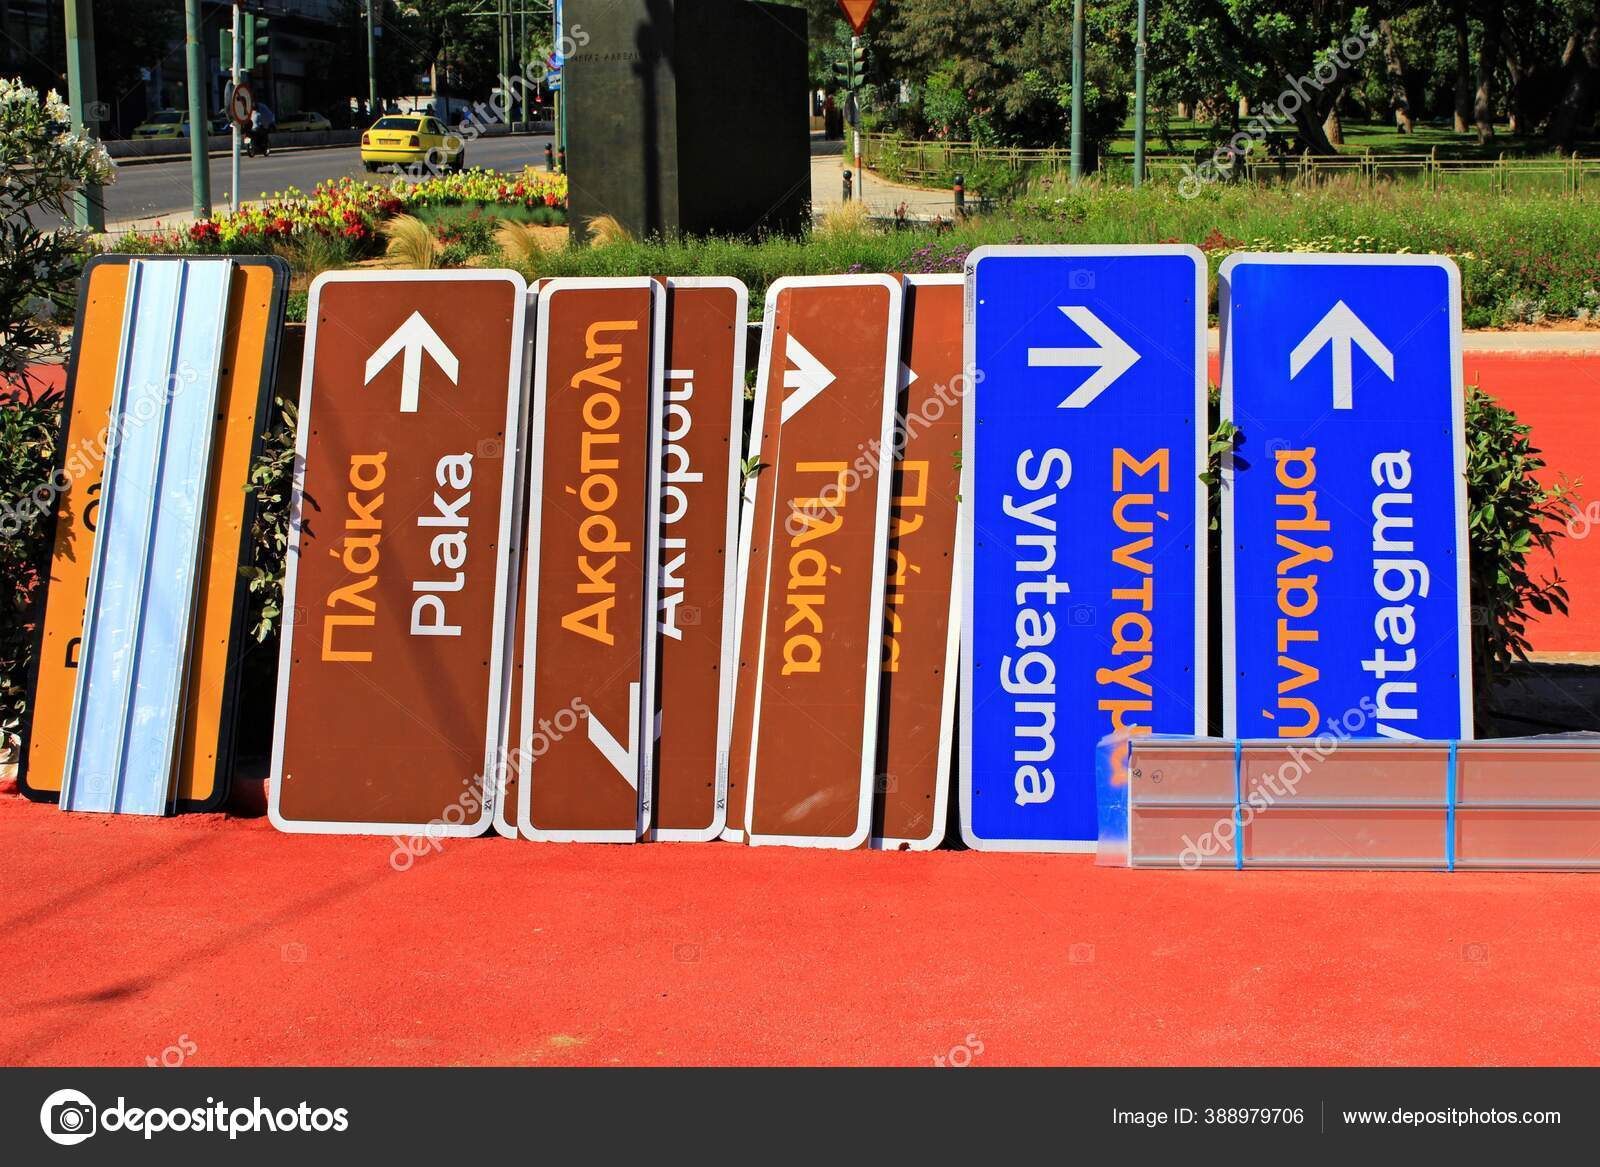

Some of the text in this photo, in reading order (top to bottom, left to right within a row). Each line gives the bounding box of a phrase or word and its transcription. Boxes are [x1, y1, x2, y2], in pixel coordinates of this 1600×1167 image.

[321, 451, 388, 662] Πλάκα
[410, 452, 474, 636] Plaka
[562, 321, 638, 645] Ακρόπολη
[781, 461, 849, 676] Πλάκα
[1001, 448, 1072, 807] Syntagma
[1262, 447, 1334, 737] ύνταγμα
[1361, 449, 1431, 740] ntagma
